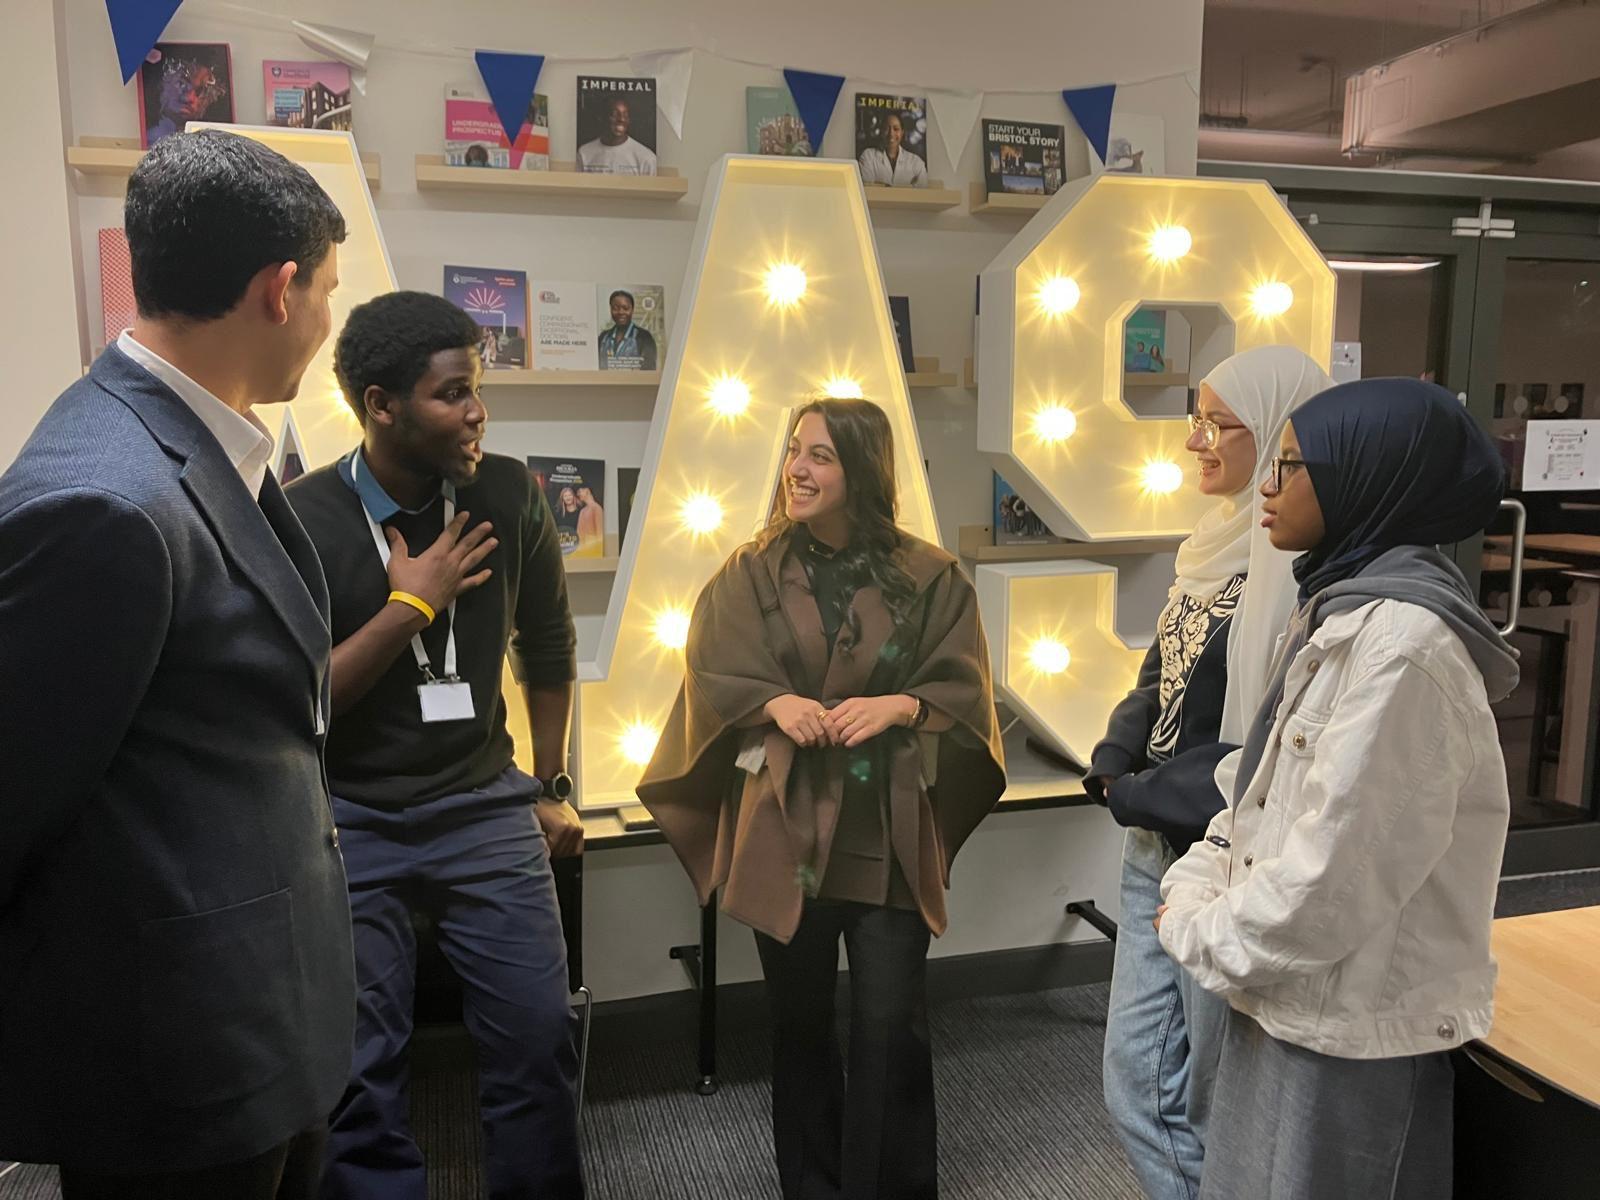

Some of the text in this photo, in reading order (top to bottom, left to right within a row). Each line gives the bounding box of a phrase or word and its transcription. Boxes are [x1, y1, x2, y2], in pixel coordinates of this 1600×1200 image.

[581, 79, 652, 91] IMPERIAL
[988, 123, 1041, 137] START YOUR
[988, 133, 1060, 147] BRISTOL STORY
[577, 153, 943, 812] A
